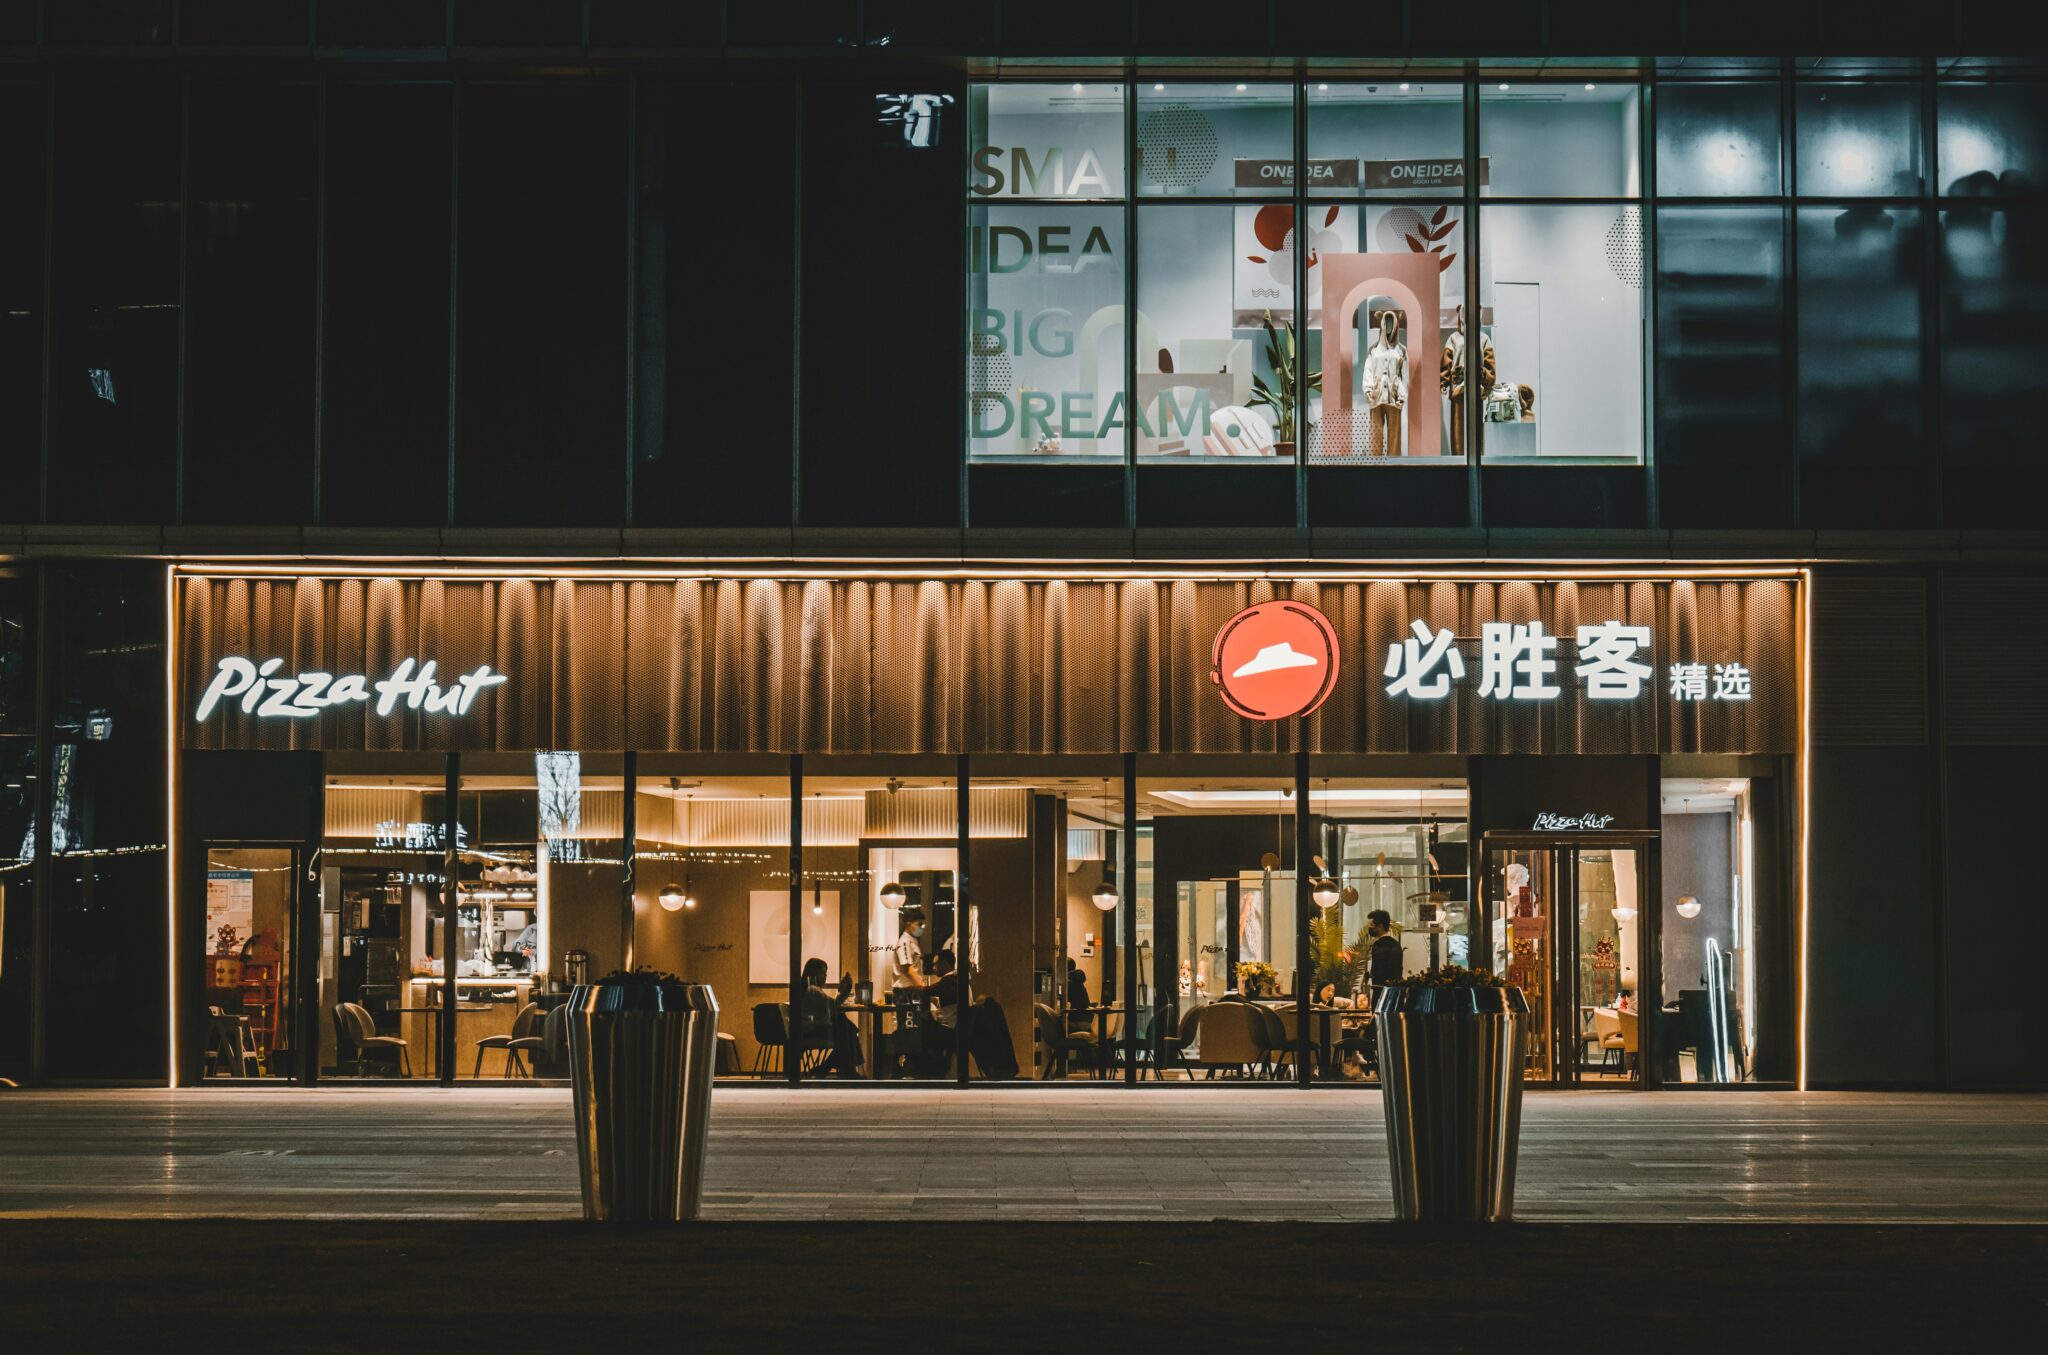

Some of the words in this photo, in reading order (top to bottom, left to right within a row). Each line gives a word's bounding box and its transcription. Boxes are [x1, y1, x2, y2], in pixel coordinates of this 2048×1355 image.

[970, 146, 1178, 195] SMA
[1260, 165, 1334, 178] ONEEA
[1390, 163, 1464, 178] ONEIDEA
[970, 226, 1120, 274] IDEA
[971, 308, 1074, 358] BIG
[1383, 619, 1653, 699] 必胜客
[1669, 662, 1752, 701] 精选
[195, 656, 370, 722] Pizza
[374, 657, 508, 716] Hut
[1533, 812, 1579, 830] Pizza
[1579, 812, 1614, 829] Hut
